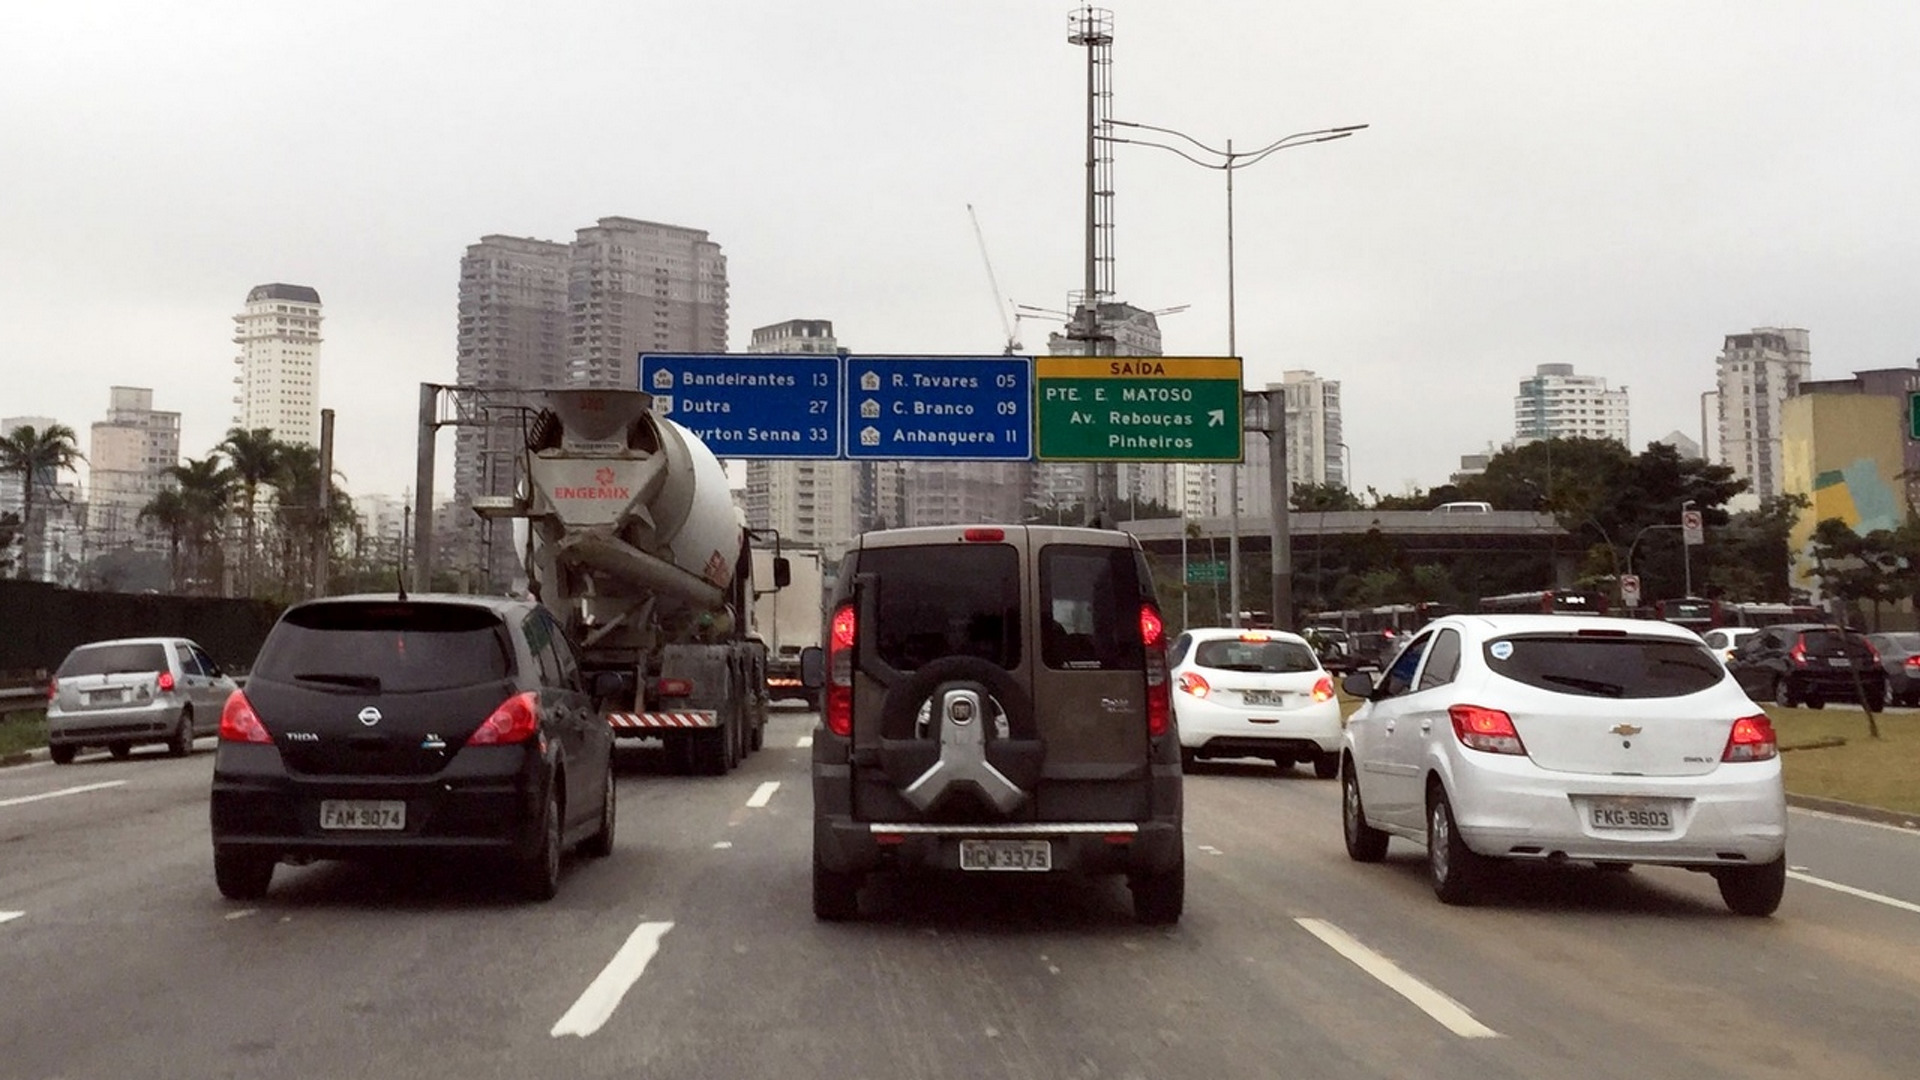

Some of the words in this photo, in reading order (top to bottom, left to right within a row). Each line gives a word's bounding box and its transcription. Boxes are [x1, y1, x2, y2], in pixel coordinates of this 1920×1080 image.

[1110, 360, 1165, 375] SAÍDA
[682, 371, 795, 386] Bandeirantes
[812, 373, 829, 387] 13
[892, 373, 908, 387] R.
[913, 373, 978, 388] Tavares
[996, 374, 1017, 388] 05
[1122, 388, 1192, 401] MATOSO
[682, 399, 731, 413] Dutra
[809, 400, 828, 414] 27
[892, 401, 908, 415] C.
[914, 401, 974, 415] Branco
[997, 401, 1017, 415] 09
[1070, 411, 1096, 424] Av.
[1109, 411, 1193, 427] Rebouças
[687, 427, 743, 442] yrton
[748, 427, 801, 442] Senna
[809, 428, 828, 441] 33
[893, 428, 995, 446] Anhanguera
[1006, 429, 1017, 443] 11
[1109, 434, 1193, 448] Pinheiros
[554, 487, 629, 499] ENGEMIX
